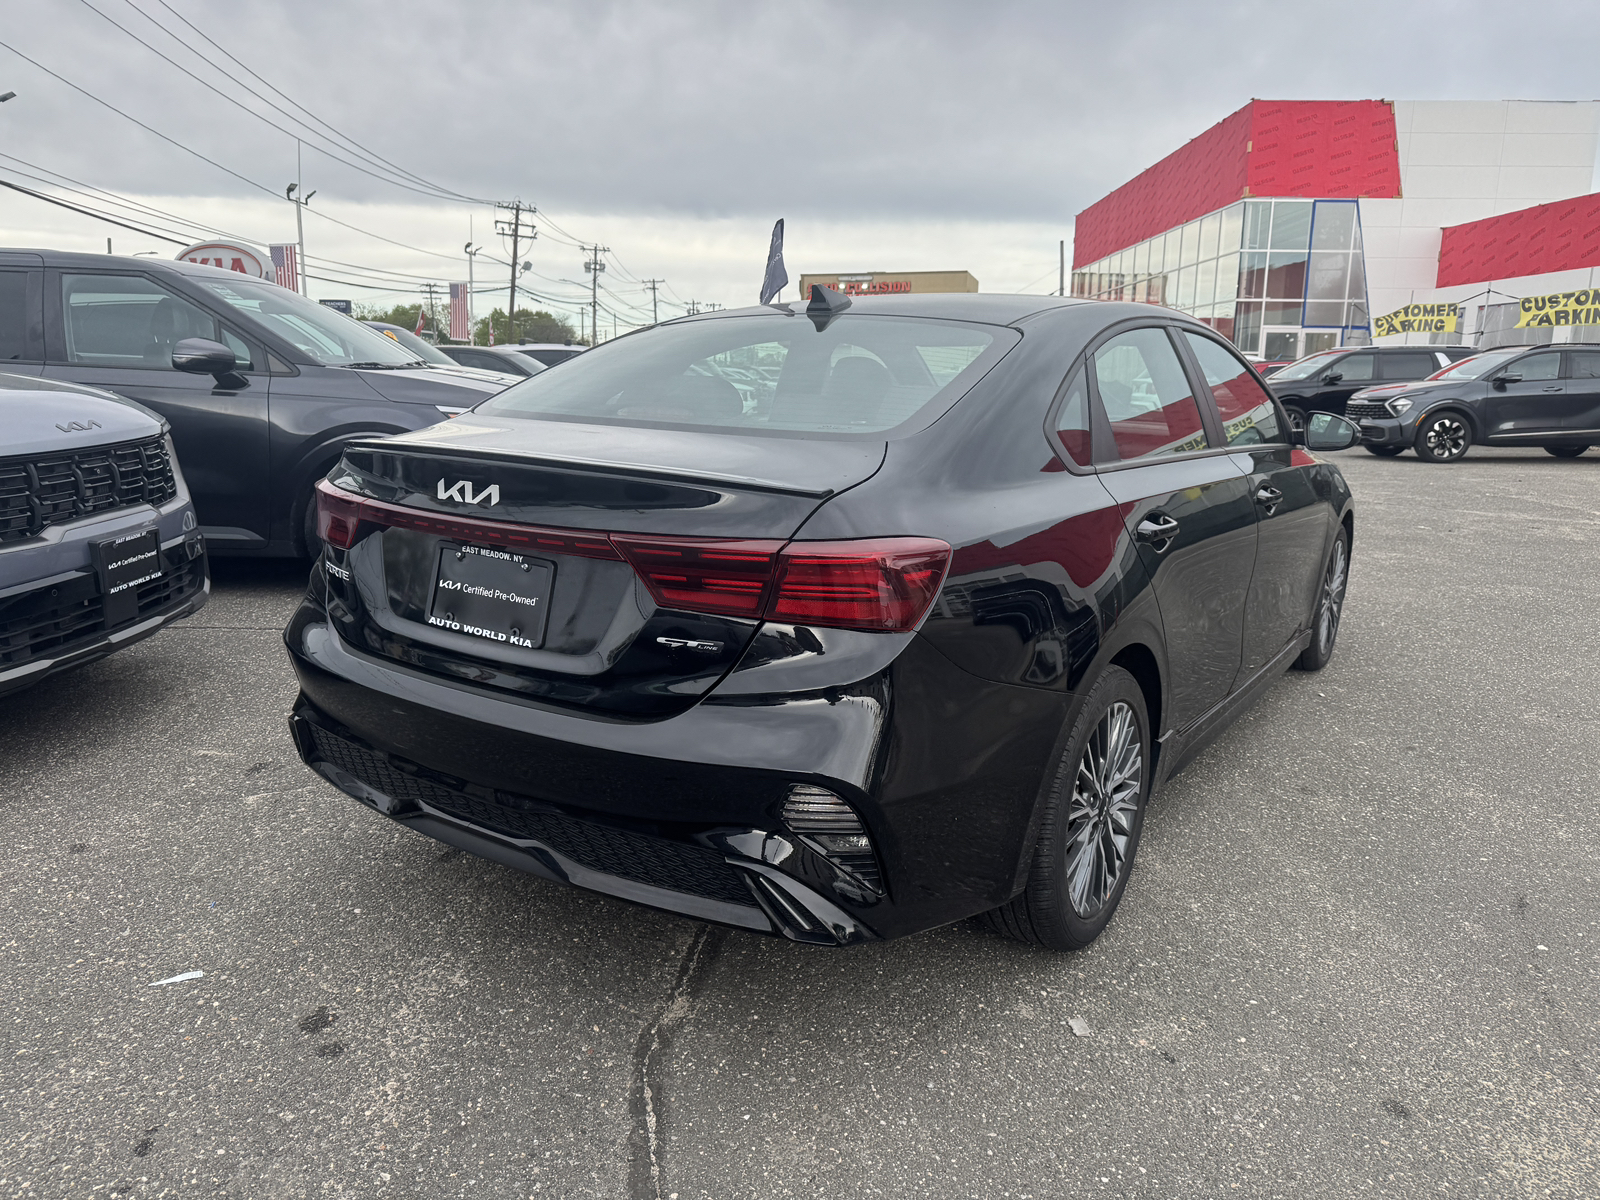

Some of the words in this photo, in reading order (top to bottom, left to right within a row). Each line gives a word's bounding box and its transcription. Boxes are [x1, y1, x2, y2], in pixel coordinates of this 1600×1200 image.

[437, 477, 500, 506] KIA
[462, 546, 479, 554] EAST
[513, 554, 524, 563] NY
[110, 584, 128, 594] AUTO
[129, 576, 150, 587] WORLD
[151, 571, 162, 579] KIA
[439, 579, 461, 590] KIA
[463, 584, 493, 598] Certified
[428, 616, 460, 630] AUTO
[463, 624, 506, 642] WORLD
[509, 635, 532, 648] KIA
